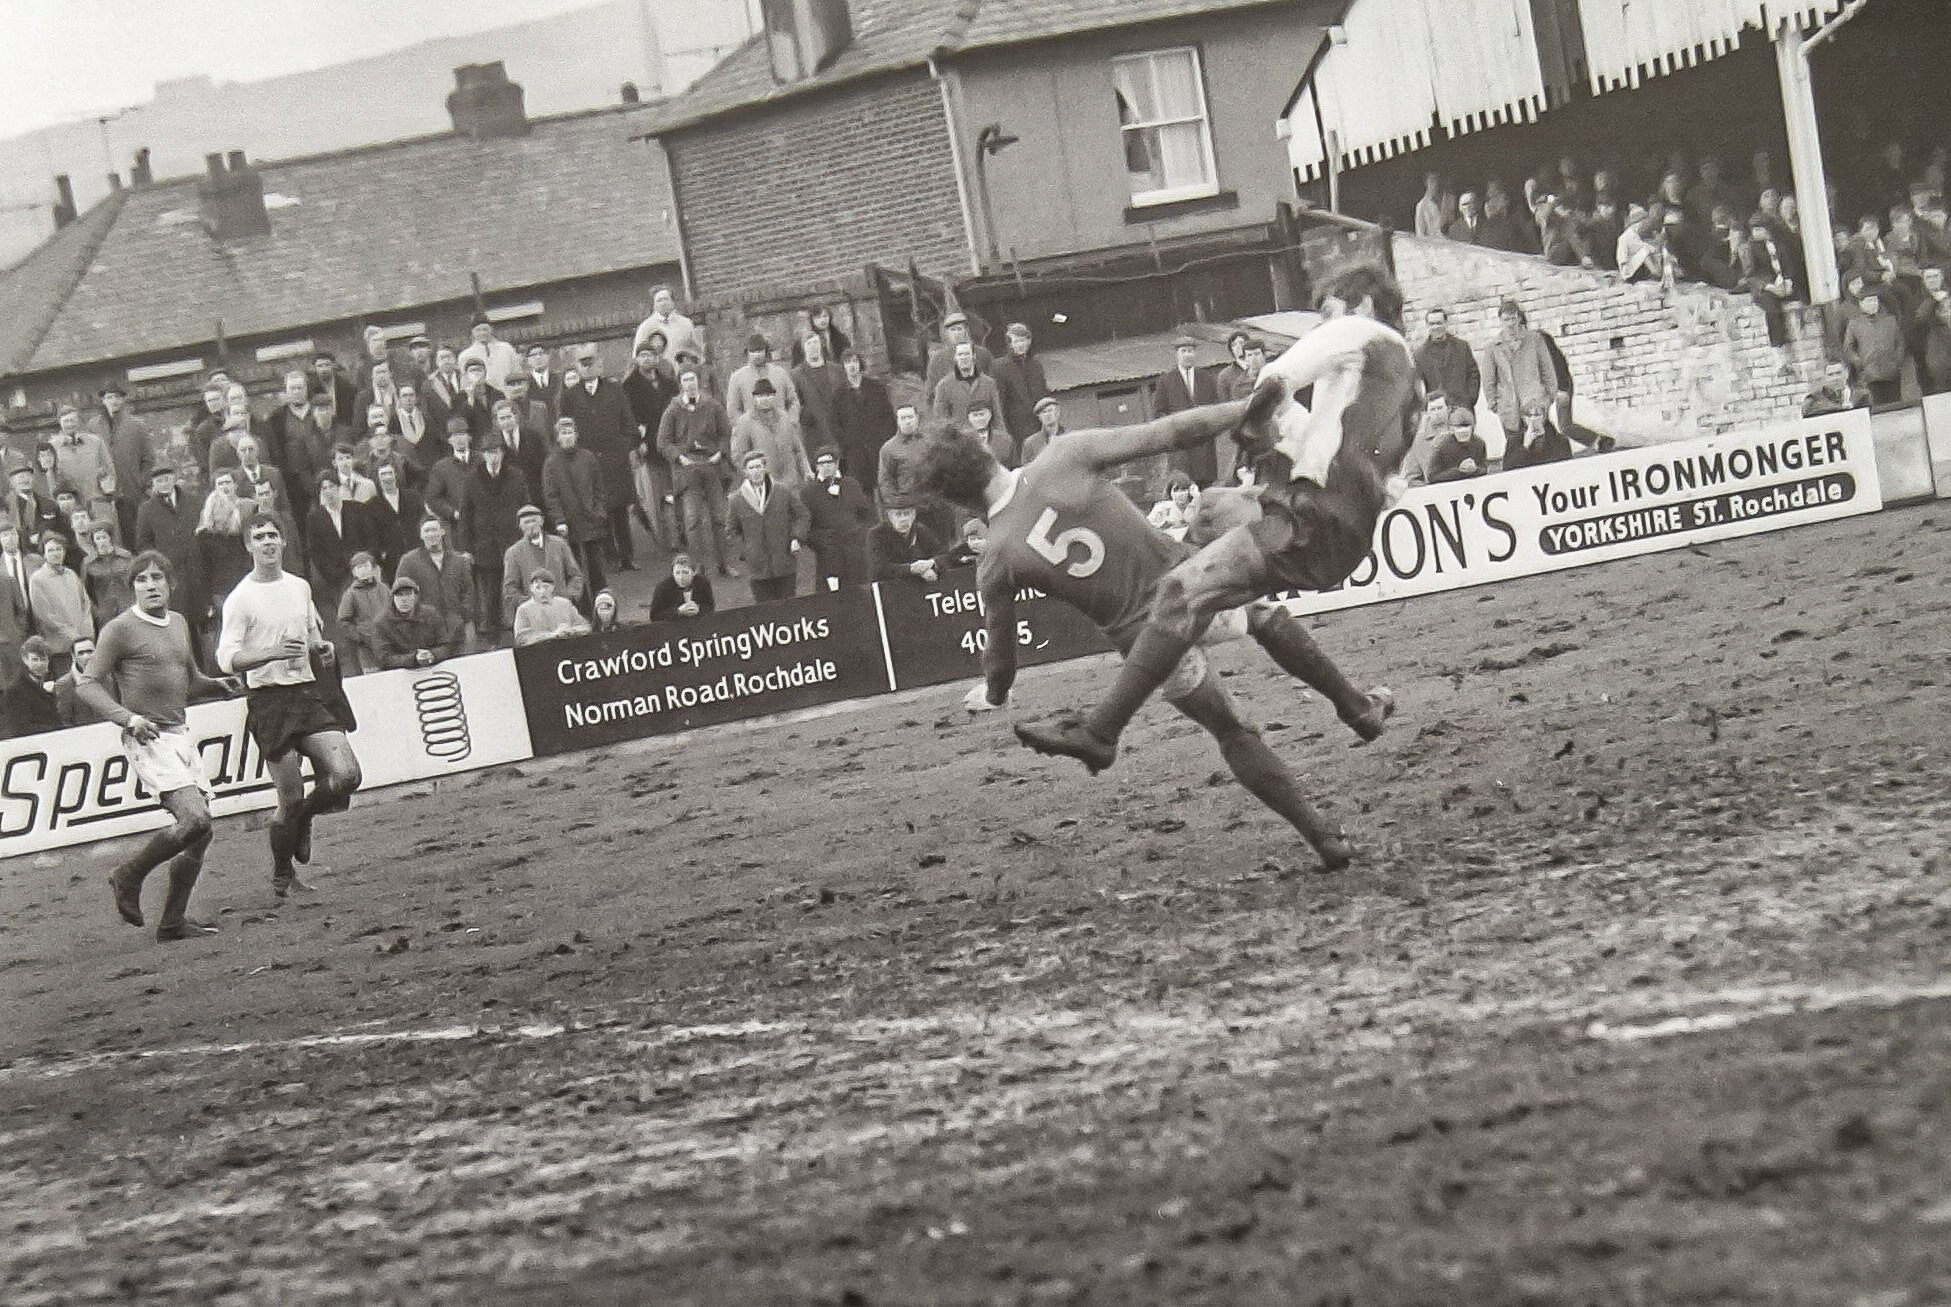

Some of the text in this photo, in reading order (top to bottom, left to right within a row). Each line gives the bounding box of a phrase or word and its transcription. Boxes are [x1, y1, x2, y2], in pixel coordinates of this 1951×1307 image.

[1531, 430, 1848, 516] Your IRONMONGER
[1026, 506, 1106, 579] 5
[1343, 490, 1517, 590] ON'S
[1547, 479, 1843, 551] YORKSHIRE ST. Rochdale
[556, 641, 673, 685] Crawford
[563, 694, 662, 729] Norman
[733, 659, 838, 697] Rochdale
